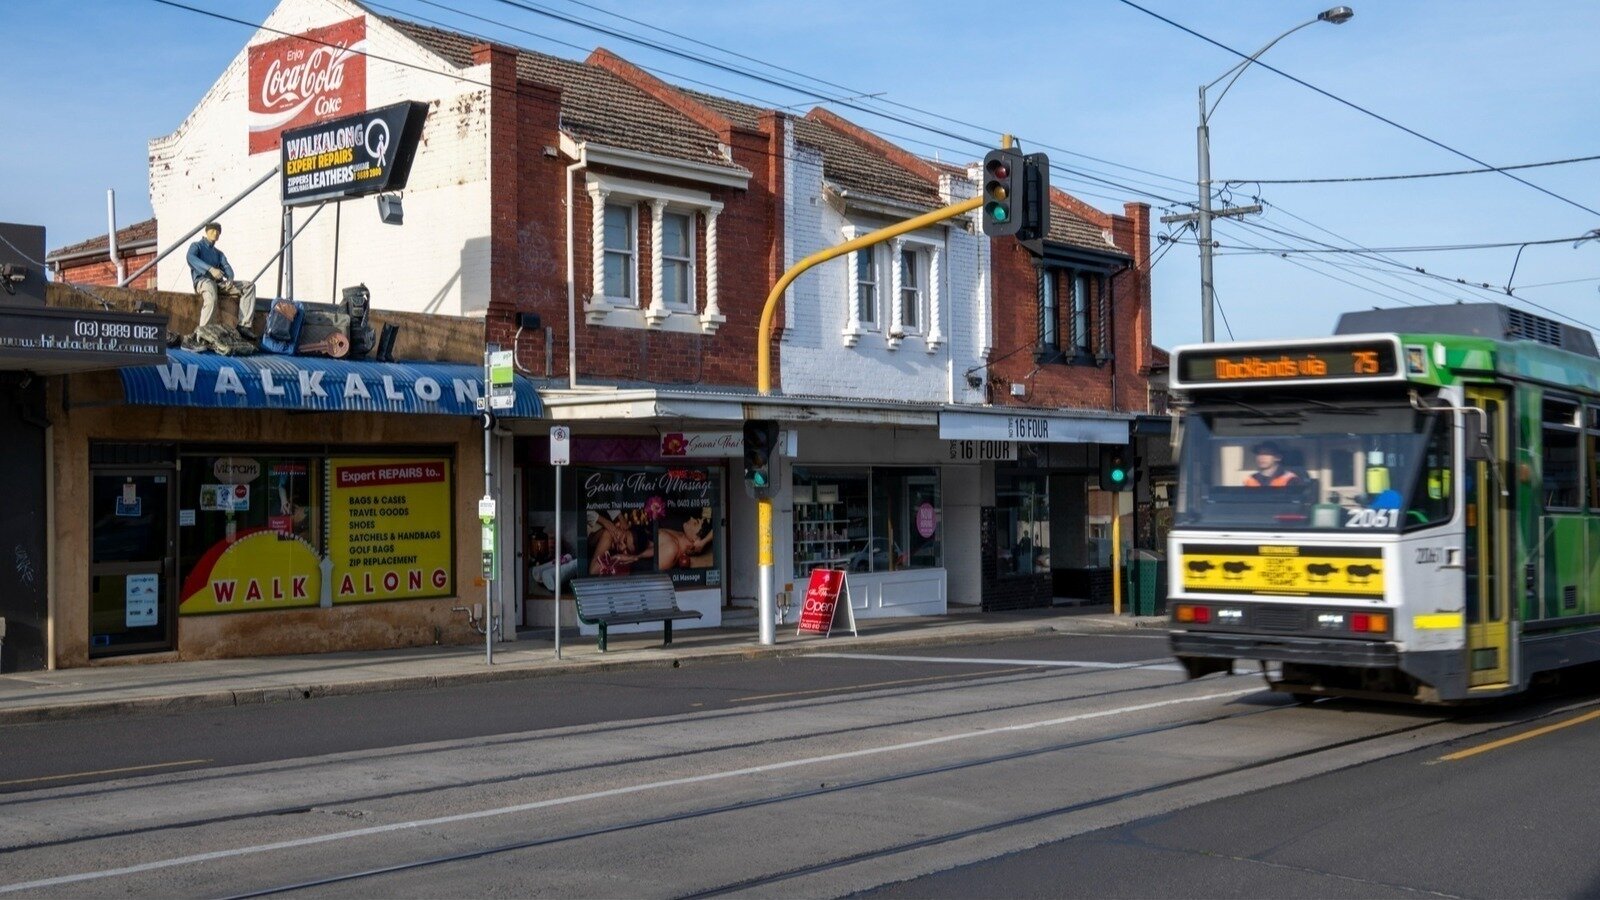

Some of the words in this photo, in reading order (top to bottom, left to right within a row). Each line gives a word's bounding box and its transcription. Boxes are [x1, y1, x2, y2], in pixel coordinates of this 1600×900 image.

[287, 50, 304, 61] Enjoy
[314, 95, 342, 116] Coke
[287, 124, 364, 160] WALKALONG
[287, 155, 317, 175] EXPERT
[318, 148, 353, 168] REPAIRS
[309, 166, 354, 189] LEATHERS
[74, 320, 98, 337] (03)
[101, 323, 131, 338] 9889
[133, 325, 159, 339] 0612
[0, 334, 159, 354] www.shibatadental.com.au
[1215, 357, 1298, 379] Docklands
[1299, 354, 1327, 376] via
[1352, 351, 1379, 373] 75
[1015, 418, 1026, 438] 16
[1027, 419, 1049, 438] FOUR
[717, 434, 739, 449] Thai
[960, 440, 973, 459] 16
[980, 441, 1009, 459] FOUR
[215, 461, 257, 474] Vibram
[341, 470, 380, 483] Expert
[378, 467, 423, 480] REPAIRS
[425, 466, 441, 478] to..
[584, 472, 625, 498] Sawai
[626, 472, 657, 493] Thai
[658, 474, 712, 497] Massage
[349, 496, 372, 505] BAGS
[373, 495, 379, 504] &
[381, 495, 406, 505] CASES
[586, 502, 610, 510] Authentic
[611, 501, 622, 509] Thai
[623, 501, 645, 510] Massage
[349, 508, 377, 517] TRAVEL
[379, 507, 409, 516] GOODS
[1345, 508, 1400, 528] 2061
[349, 520, 375, 529] SHOES
[349, 534, 388, 542] SATCHELS
[389, 533, 396, 541] &
[398, 531, 440, 541] HANDBAGS
[349, 546, 370, 555] GOLF
[372, 544, 394, 554] BAGS
[349, 558, 362, 567] ZIP
[363, 556, 417, 566] REPLACEMENT
[213, 576, 309, 603] WALK
[339, 568, 447, 596] ALONG
[681, 573, 701, 583] Massage
[806, 598, 834, 614] Open
